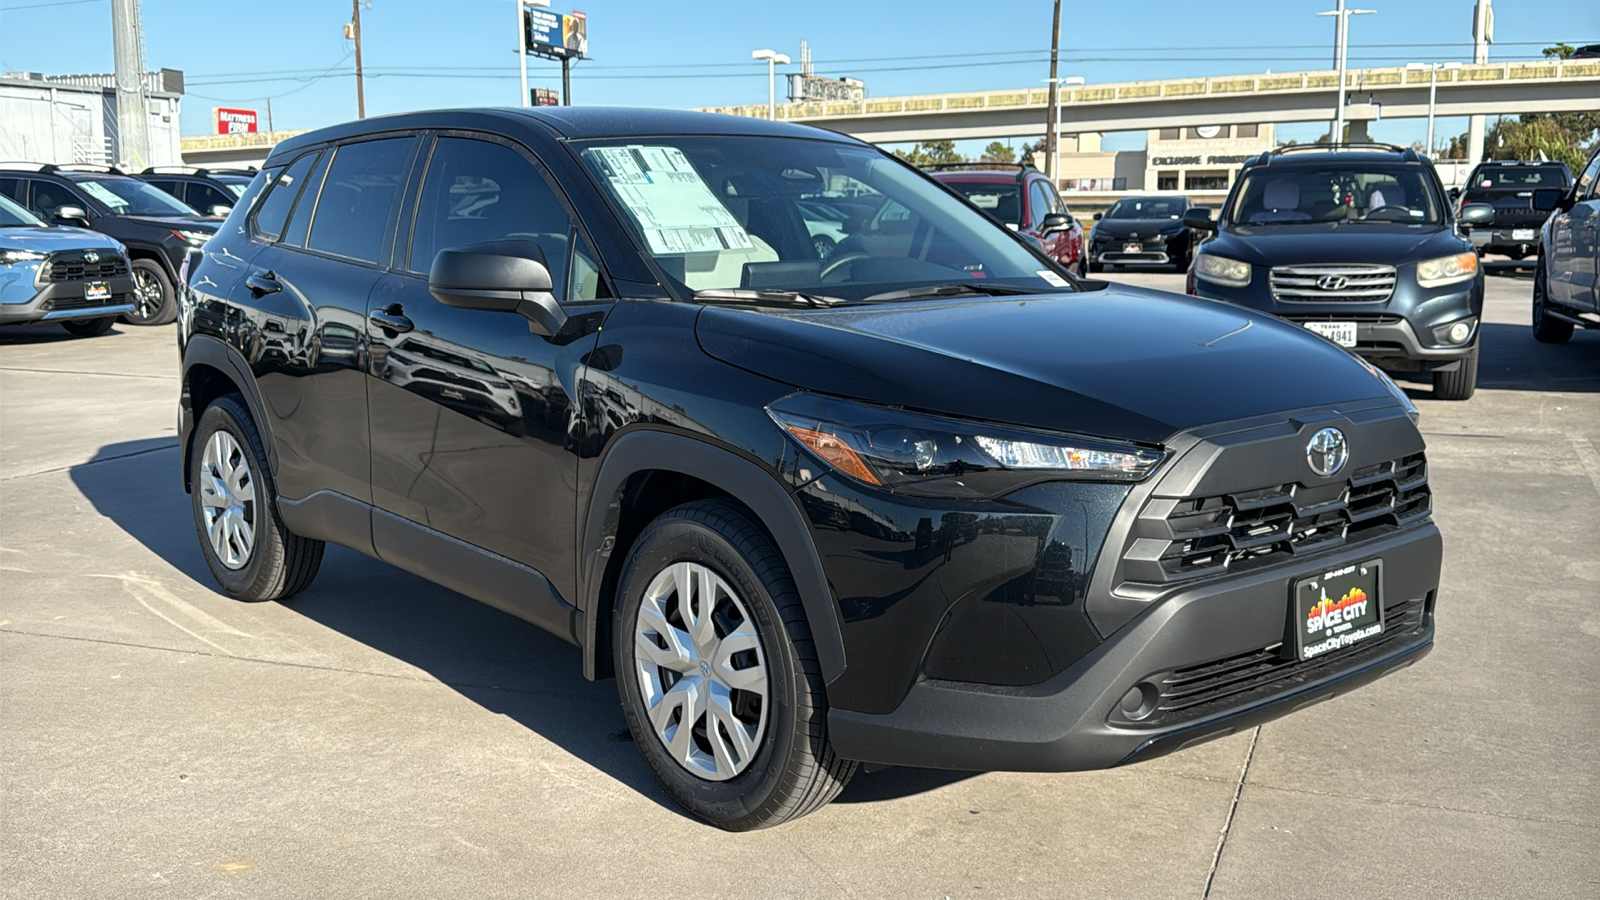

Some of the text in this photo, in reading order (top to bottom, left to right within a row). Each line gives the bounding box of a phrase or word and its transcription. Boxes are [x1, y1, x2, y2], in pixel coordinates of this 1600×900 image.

[228, 122, 248, 134] FIRM
[1307, 600, 1367, 634] SPACE CITY
[1303, 624, 1381, 658] SpaceCityToyota.com
